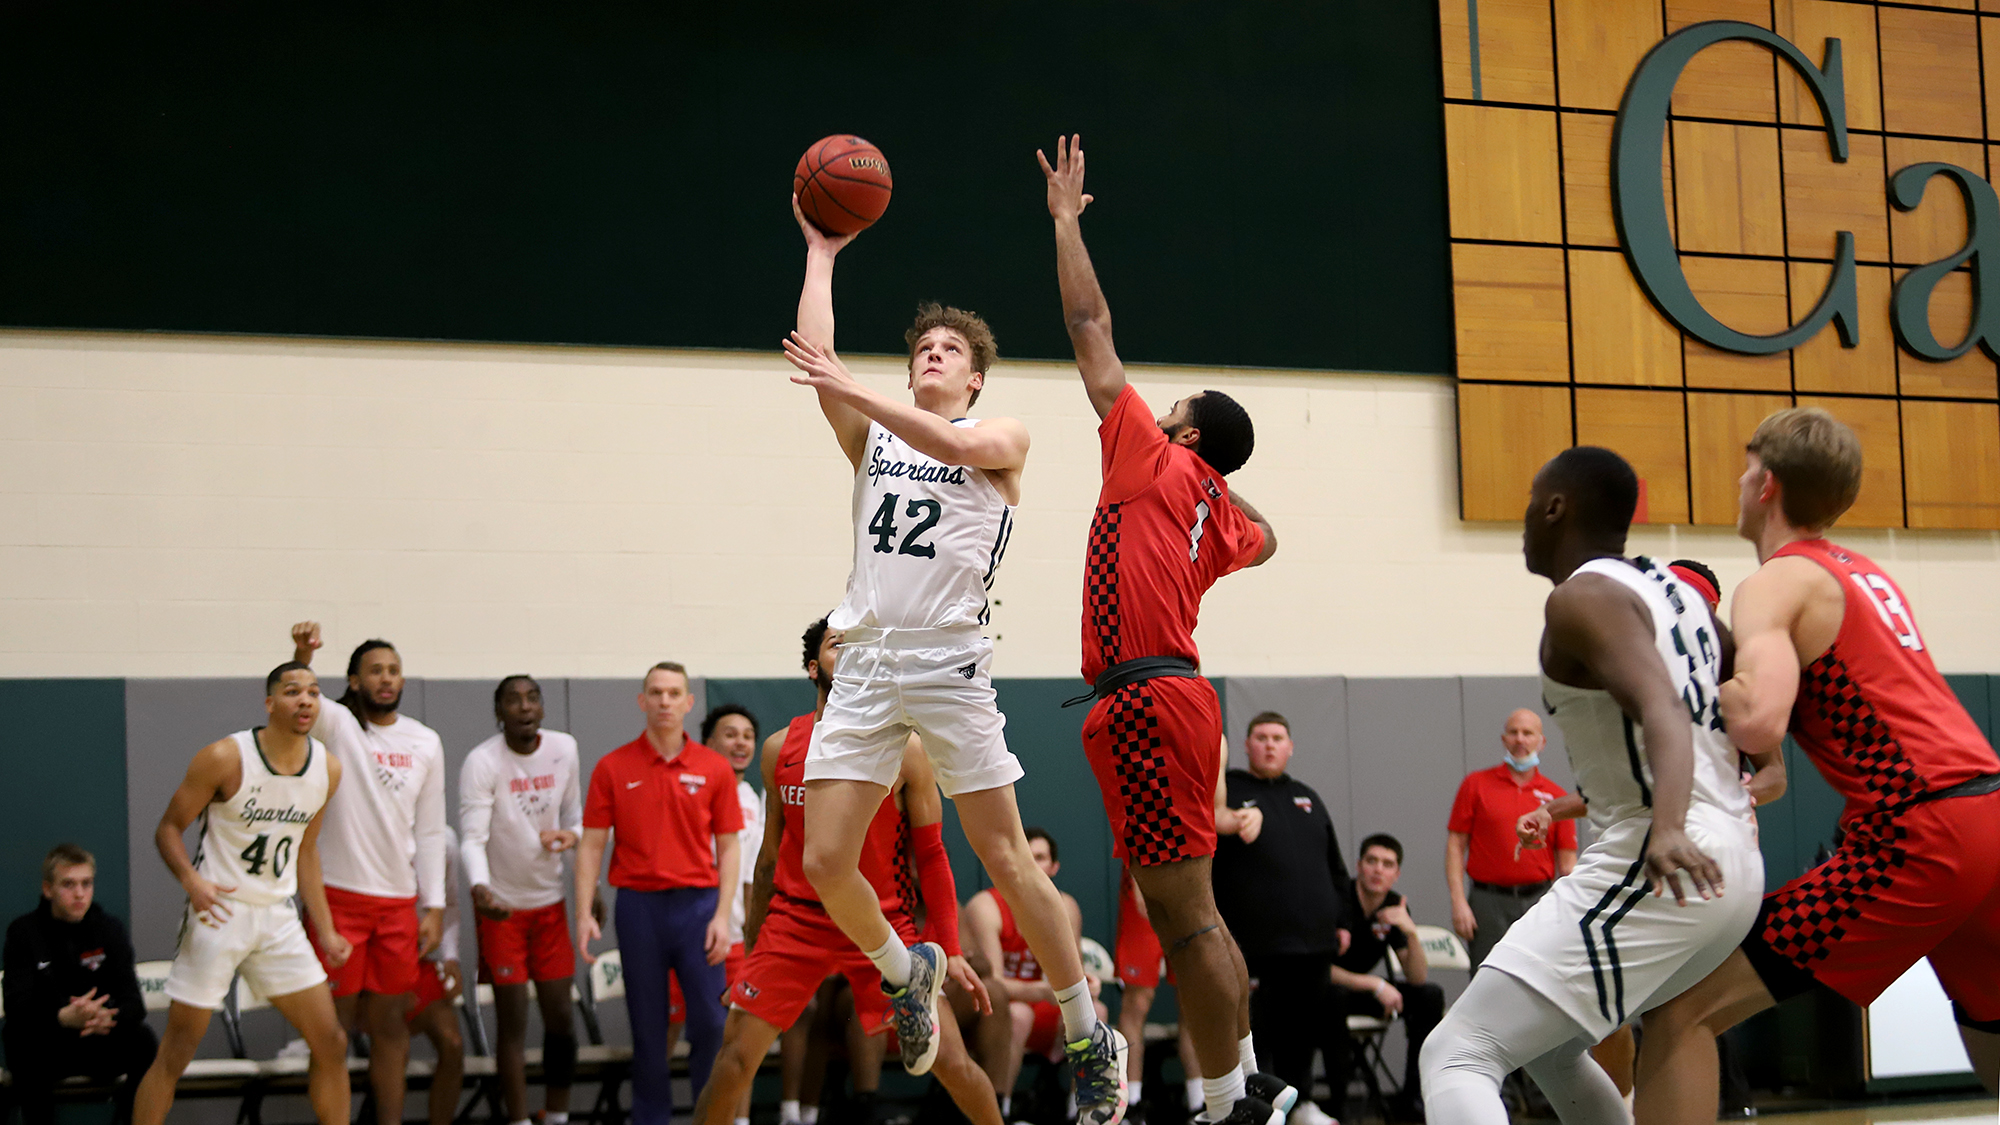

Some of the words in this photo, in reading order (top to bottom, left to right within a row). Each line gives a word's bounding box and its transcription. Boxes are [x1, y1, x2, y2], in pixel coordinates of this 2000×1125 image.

[868, 446, 966, 487] Spartans
[868, 493, 942, 560] 42
[1189, 499, 1211, 563] 1
[1849, 571, 1923, 652] 13
[780, 785, 806, 806] KEE
[241, 834, 293, 877] 40
